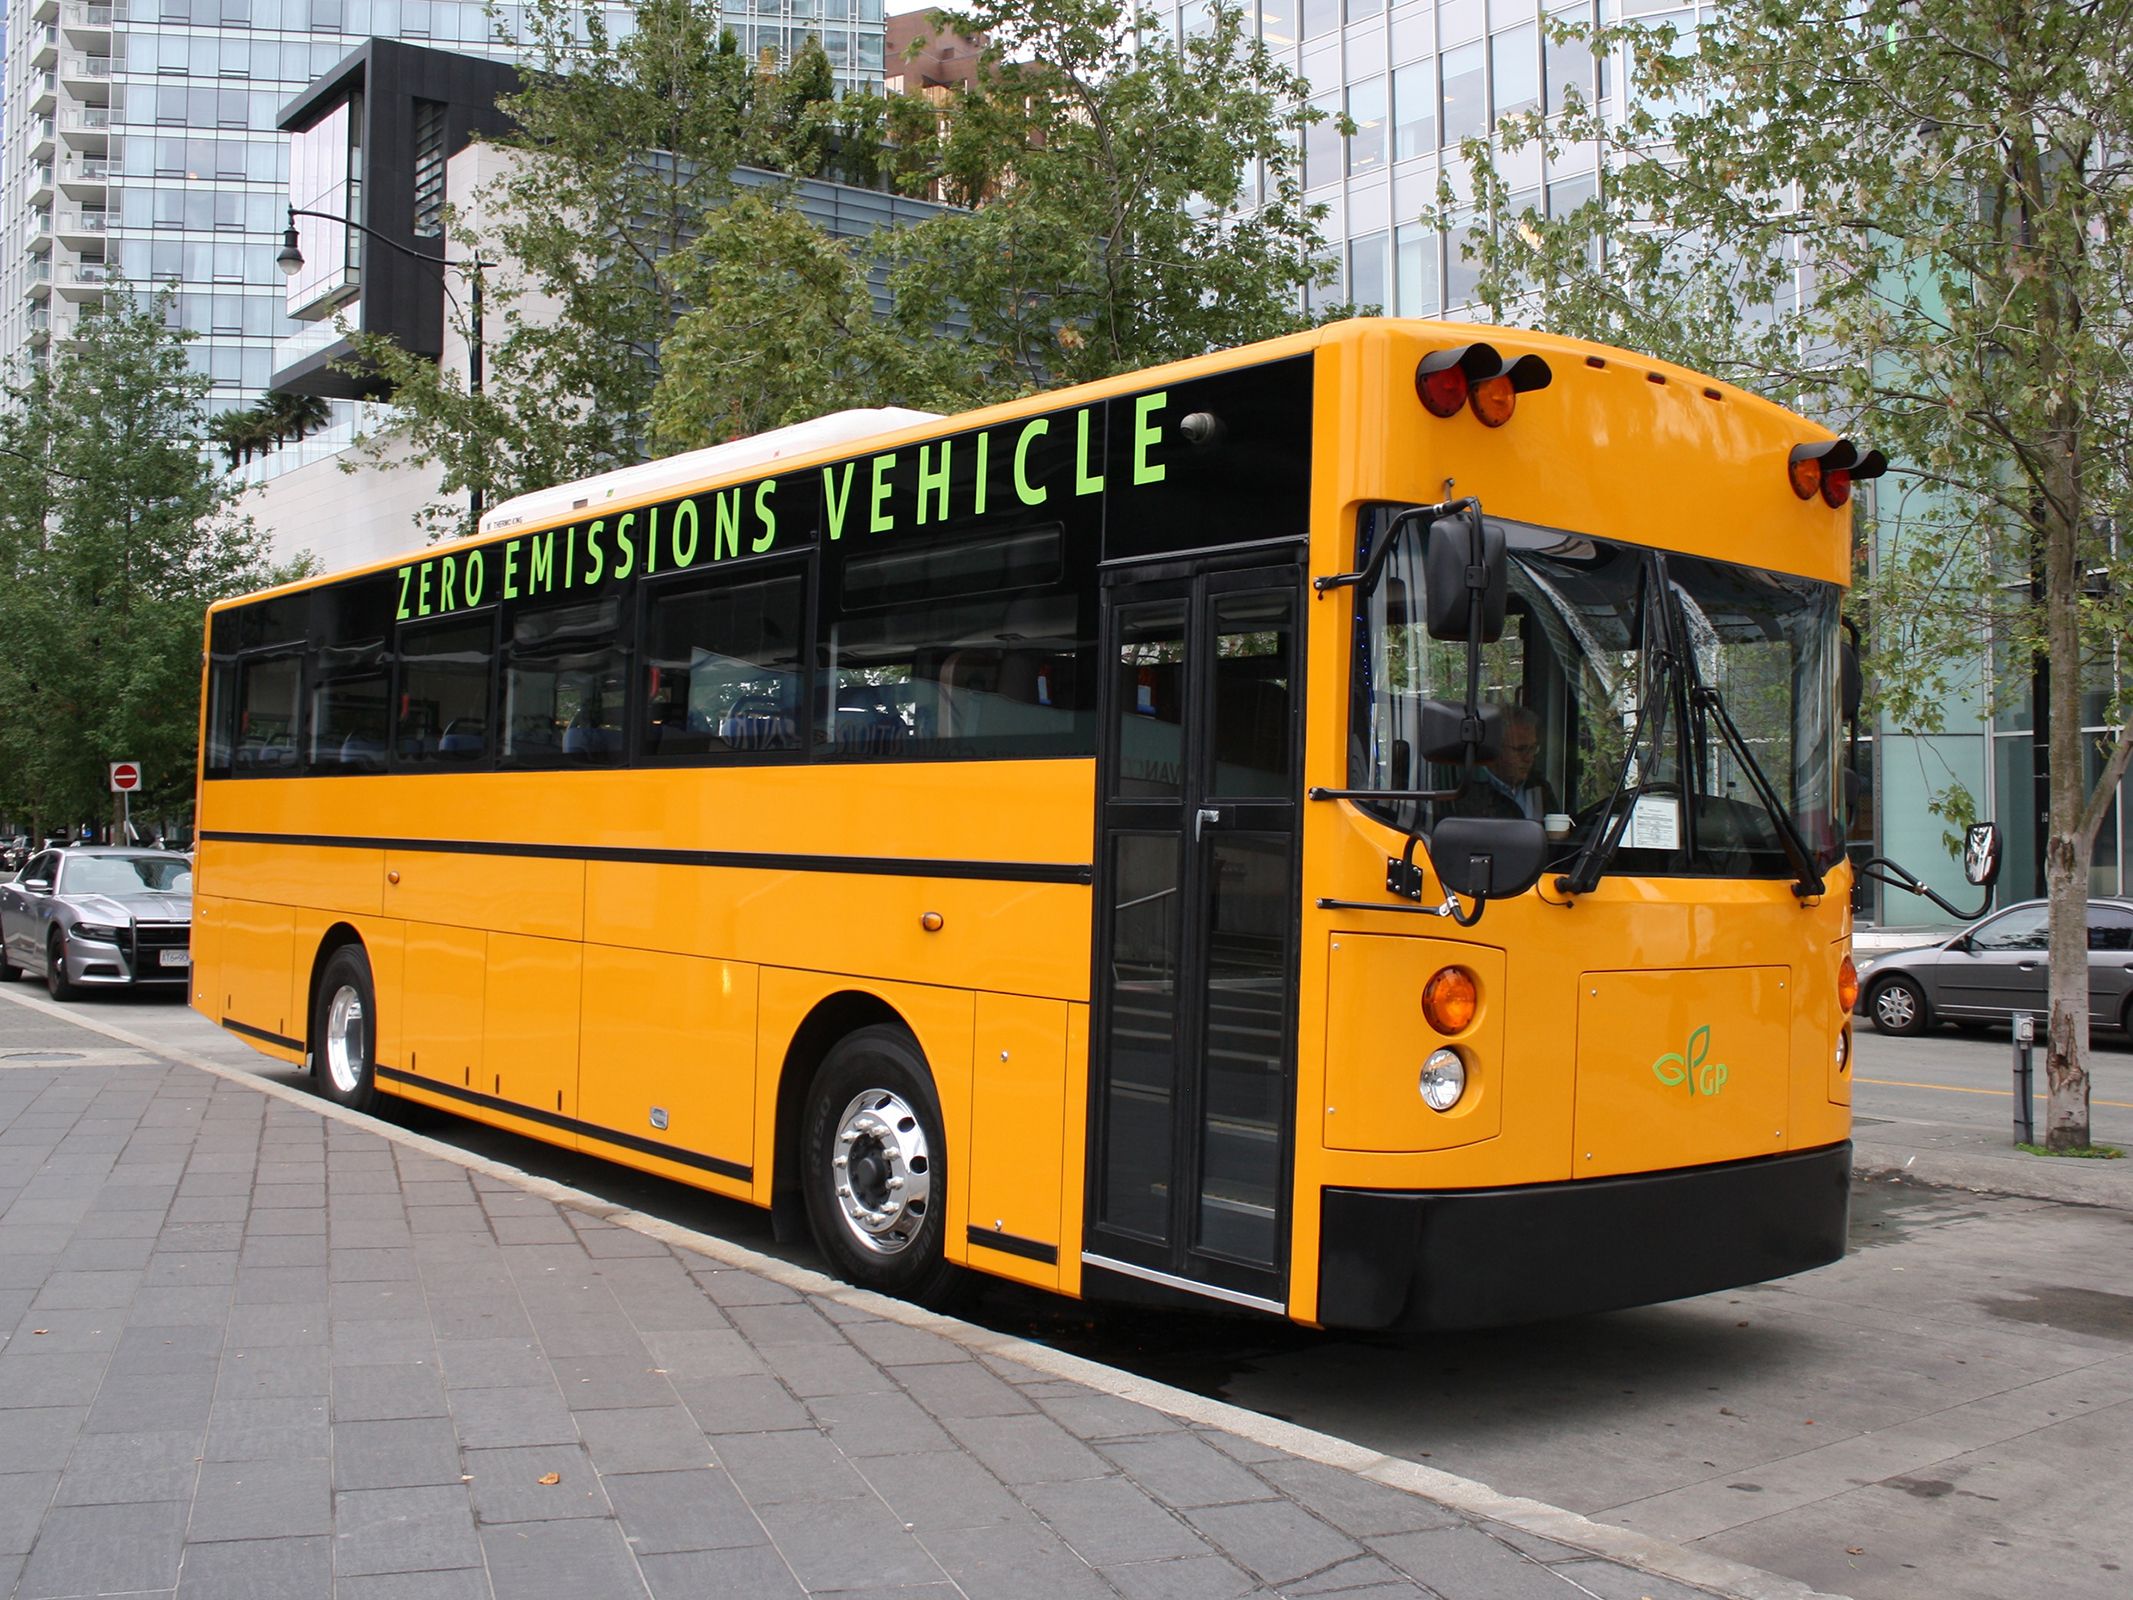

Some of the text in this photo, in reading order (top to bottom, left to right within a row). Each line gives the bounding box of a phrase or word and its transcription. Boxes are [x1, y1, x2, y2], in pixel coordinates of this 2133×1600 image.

[395, 391, 1167, 621] ZERO EMISSIONS VEHICLE
[1699, 1063, 1729, 1096] GP
